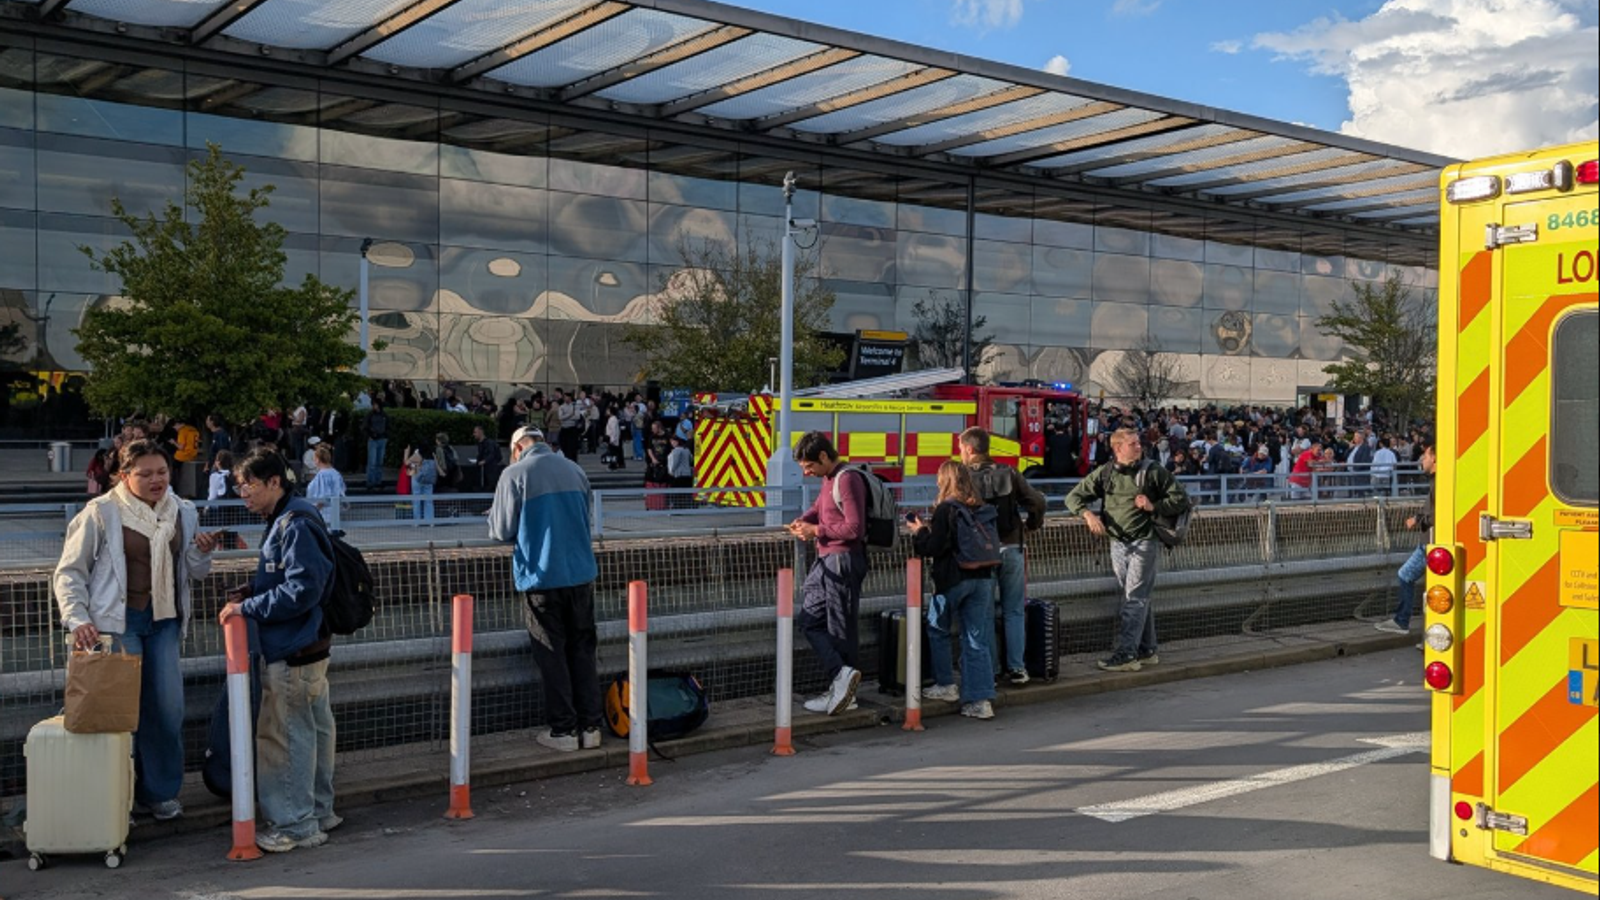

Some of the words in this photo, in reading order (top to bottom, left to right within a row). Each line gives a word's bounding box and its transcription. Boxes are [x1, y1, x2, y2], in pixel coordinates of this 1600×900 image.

[1557, 249, 1599, 284] LO
[861, 346, 893, 356] Welcome
[894, 348, 902, 356] to
[860, 356, 891, 366] Terminal
[891, 357, 897, 366] 4
[821, 401, 853, 410] Heathrow
[1028, 422, 1040, 432] 10
